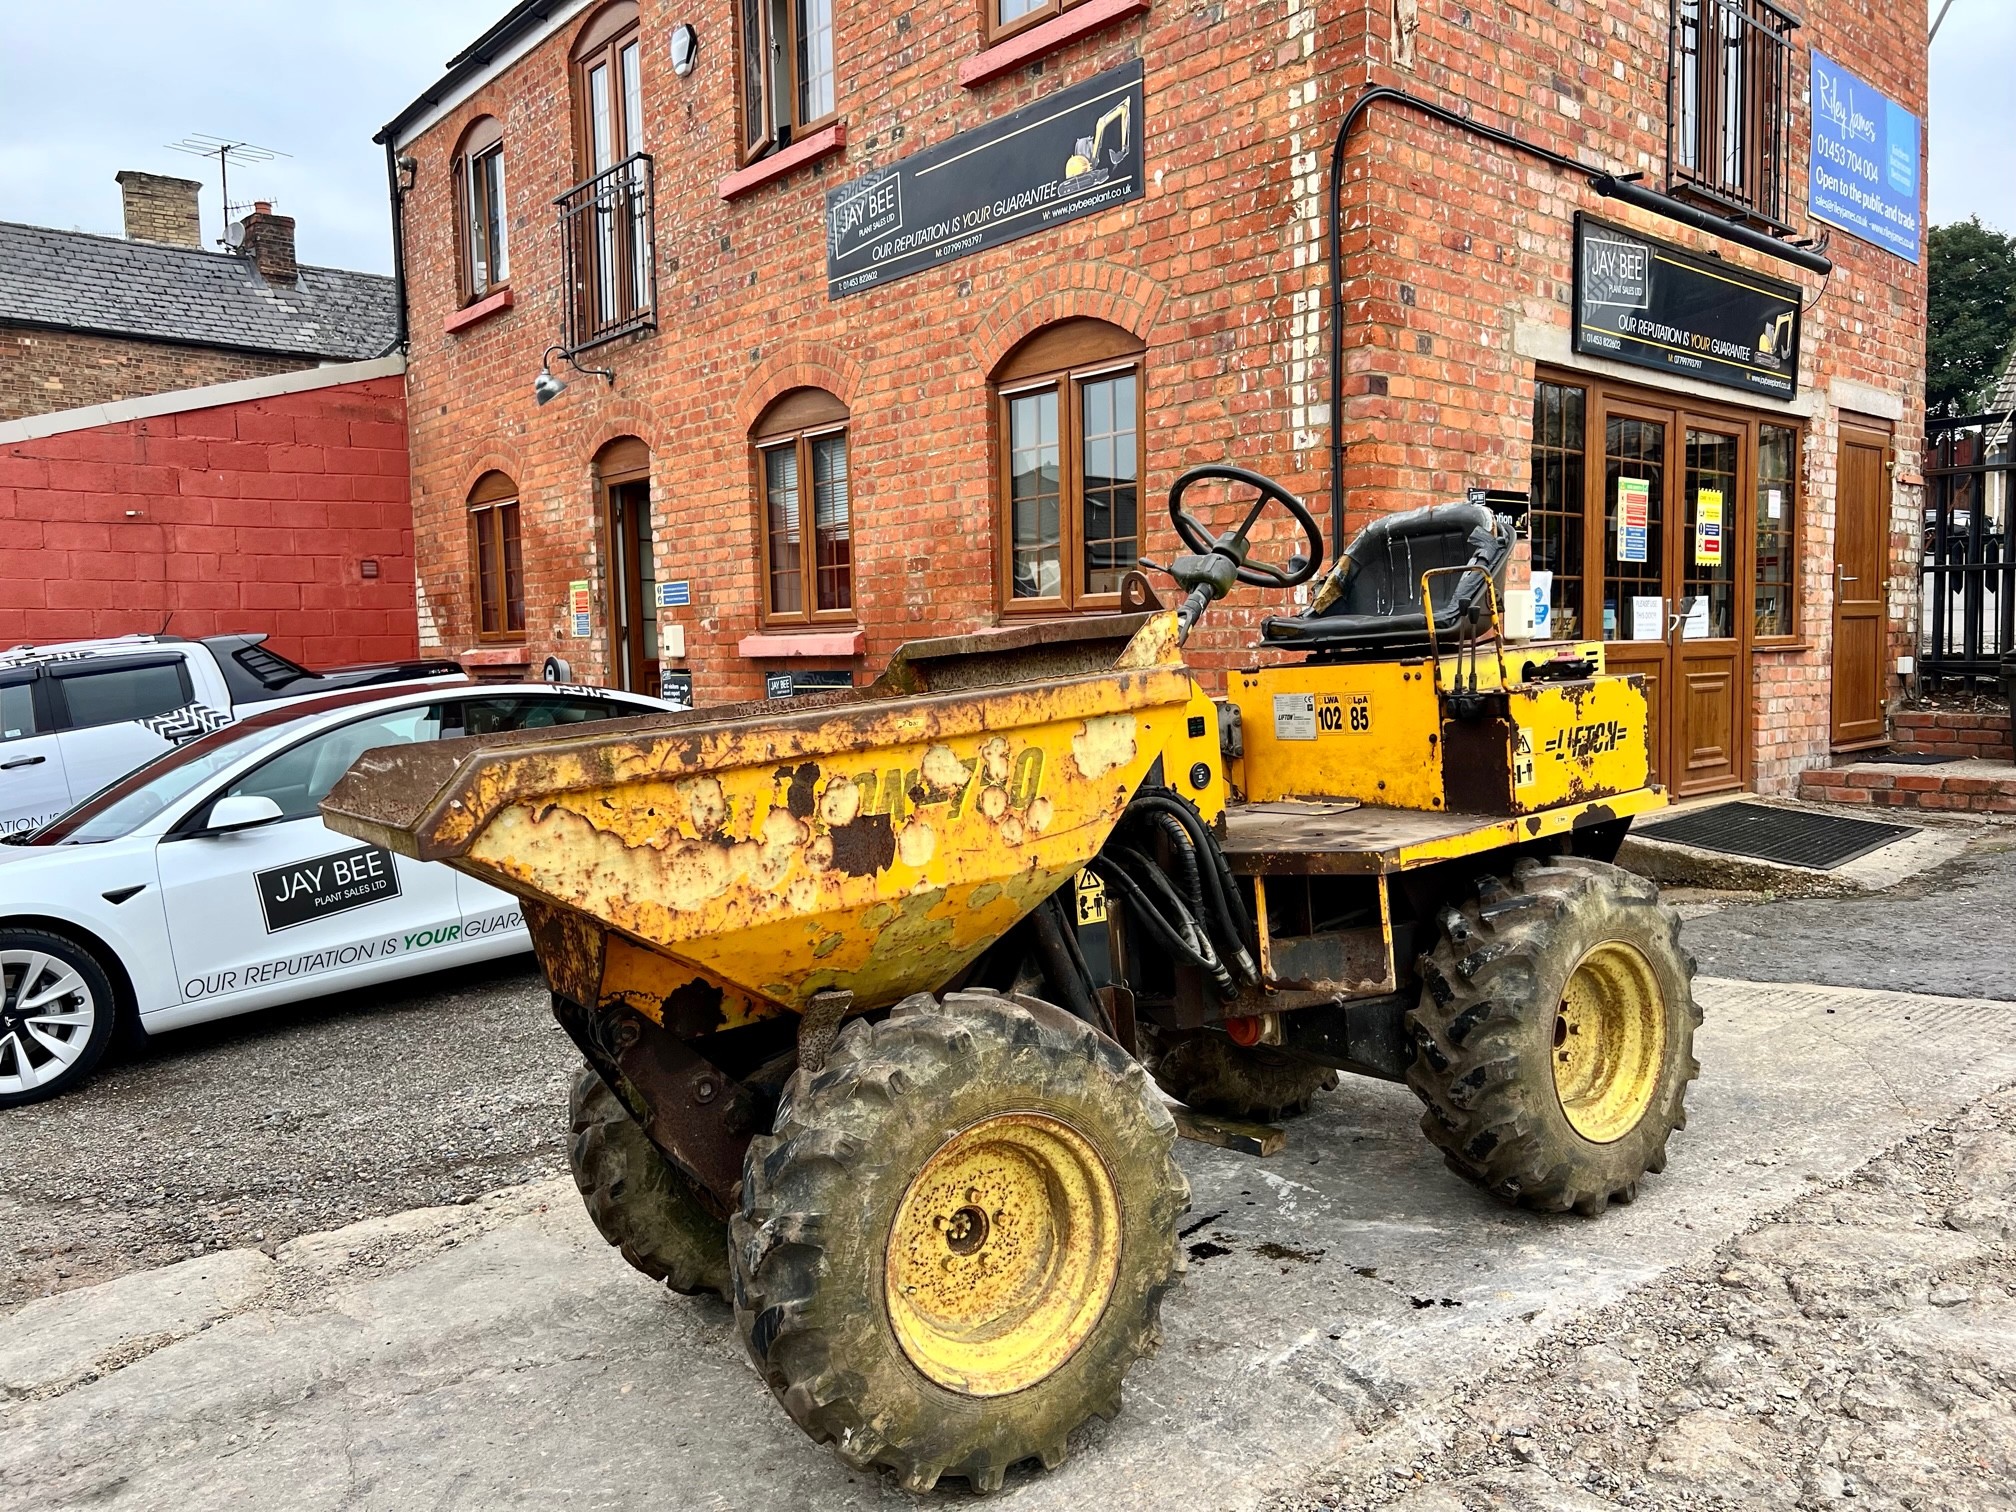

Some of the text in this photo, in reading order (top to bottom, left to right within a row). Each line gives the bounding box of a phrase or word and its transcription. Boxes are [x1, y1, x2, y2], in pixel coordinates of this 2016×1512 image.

[1817, 69, 1876, 142] Riley James
[1817, 133, 1846, 166] 01453
[1847, 149, 1862, 175] 704
[1863, 160, 1878, 184] 004
[841, 185, 895, 233] JAY BEE
[1815, 166, 1916, 232] Open to the public and trade
[858, 213, 895, 238] PLANT SALES LTD
[872, 180, 1058, 261] OUR REPUTATION IS YOUR GUARANTEE
[943, 234, 983, 256] 07799793797
[1591, 249, 1643, 281] JAY BEE
[843, 277, 859, 290] 01453
[859, 271, 878, 286] 822602
[1608, 284, 1643, 297] PLANT SALES LTD
[1586, 333, 1602, 346] 01453
[1602, 336, 1621, 351] 822602
[1618, 314, 1751, 362] OUR REPUTATION IS YOUR GUARANTEE
[770, 679, 790, 691] JAY BEE
[1323, 696, 1340, 704] LWA
[1353, 695, 1369, 705] LpA
[1318, 705, 1343, 731] 102
[1350, 706, 1369, 731] 85
[275, 850, 384, 902] JAY BEE
[314, 879, 387, 907] PLANT SALES LTD
[185, 971, 237, 999] OUR
[244, 942, 375, 986] REPUTATION
[380, 938, 398, 956] IS
[404, 925, 461, 950] YOUR
